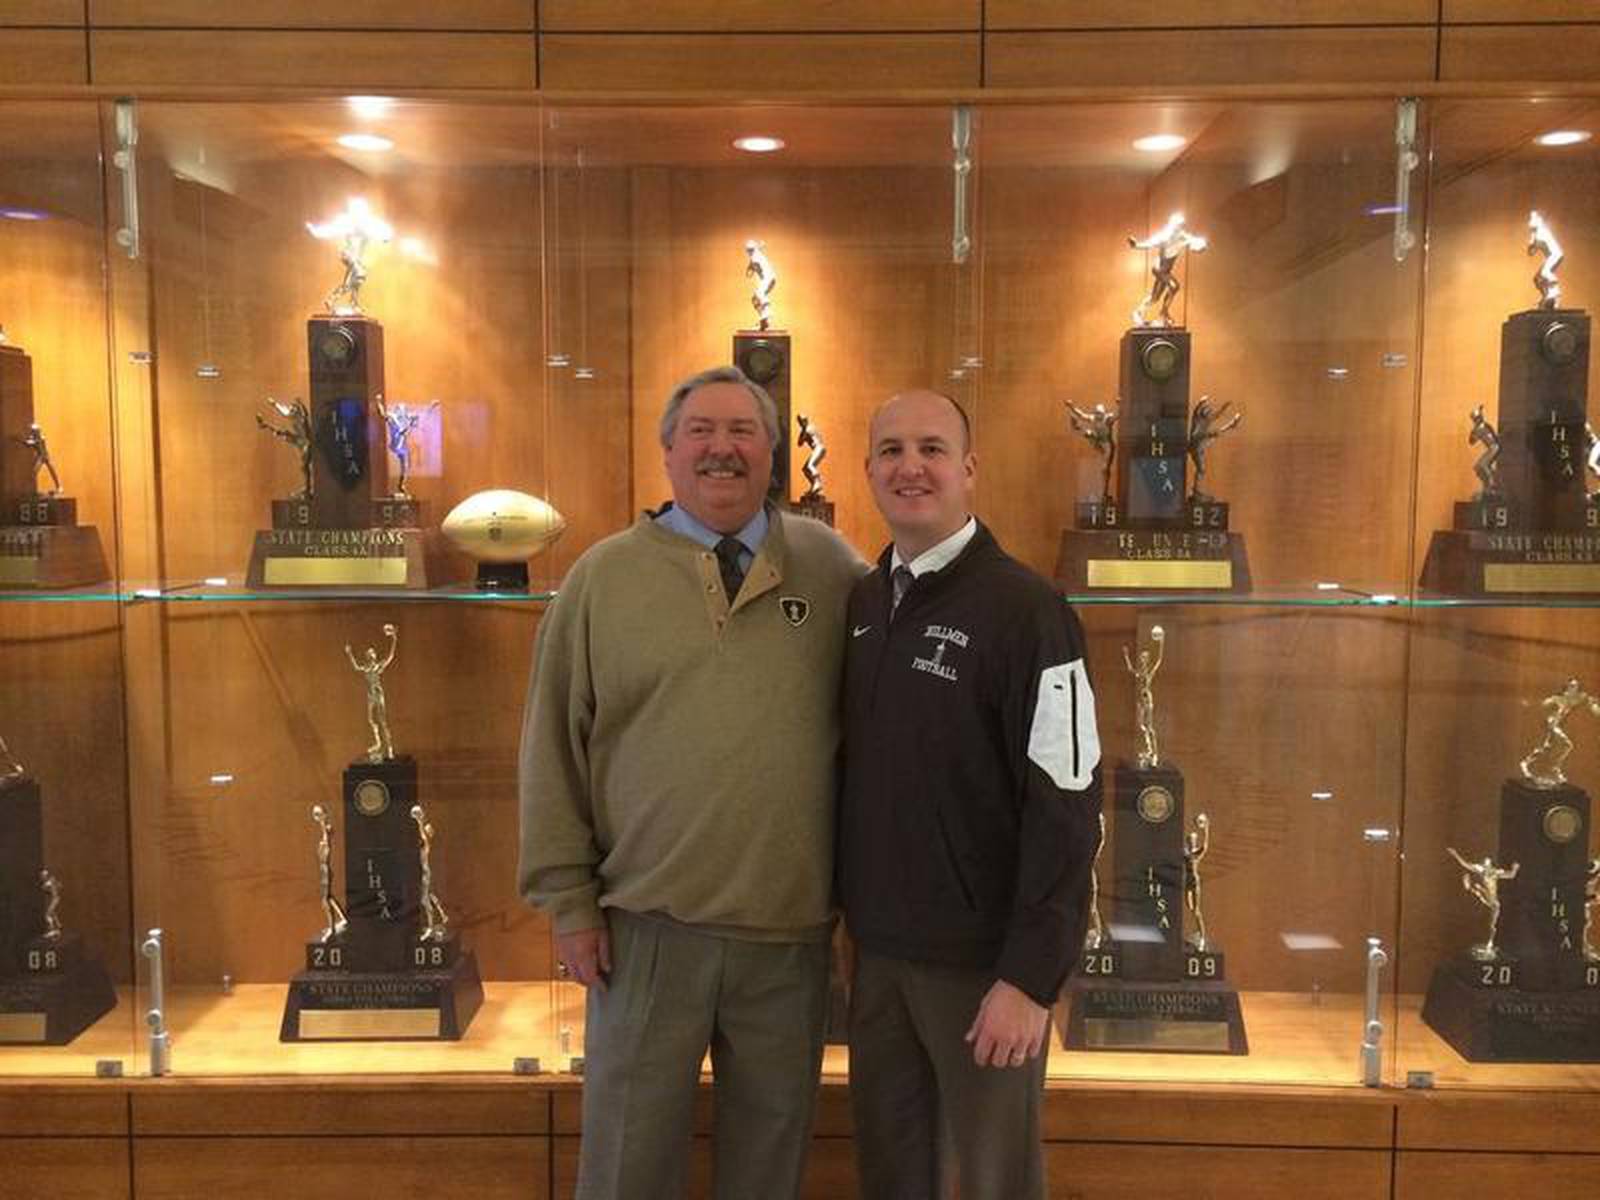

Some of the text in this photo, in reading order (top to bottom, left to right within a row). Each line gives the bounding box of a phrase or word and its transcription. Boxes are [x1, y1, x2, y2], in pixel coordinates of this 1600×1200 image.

[1150, 424, 1174, 491] IHSA
[1550, 411, 1575, 477] IHSA
[1192, 507, 1220, 525] 92
[320, 530, 404, 544] CHAMPIONS
[366, 858, 393, 919] IHSA
[1148, 866, 1171, 929] IHSA
[1551, 886, 1572, 949] IHSA
[313, 947, 443, 967] 20 08
[1085, 955, 1216, 977] 20 09
[1481, 965, 1512, 985] 20
